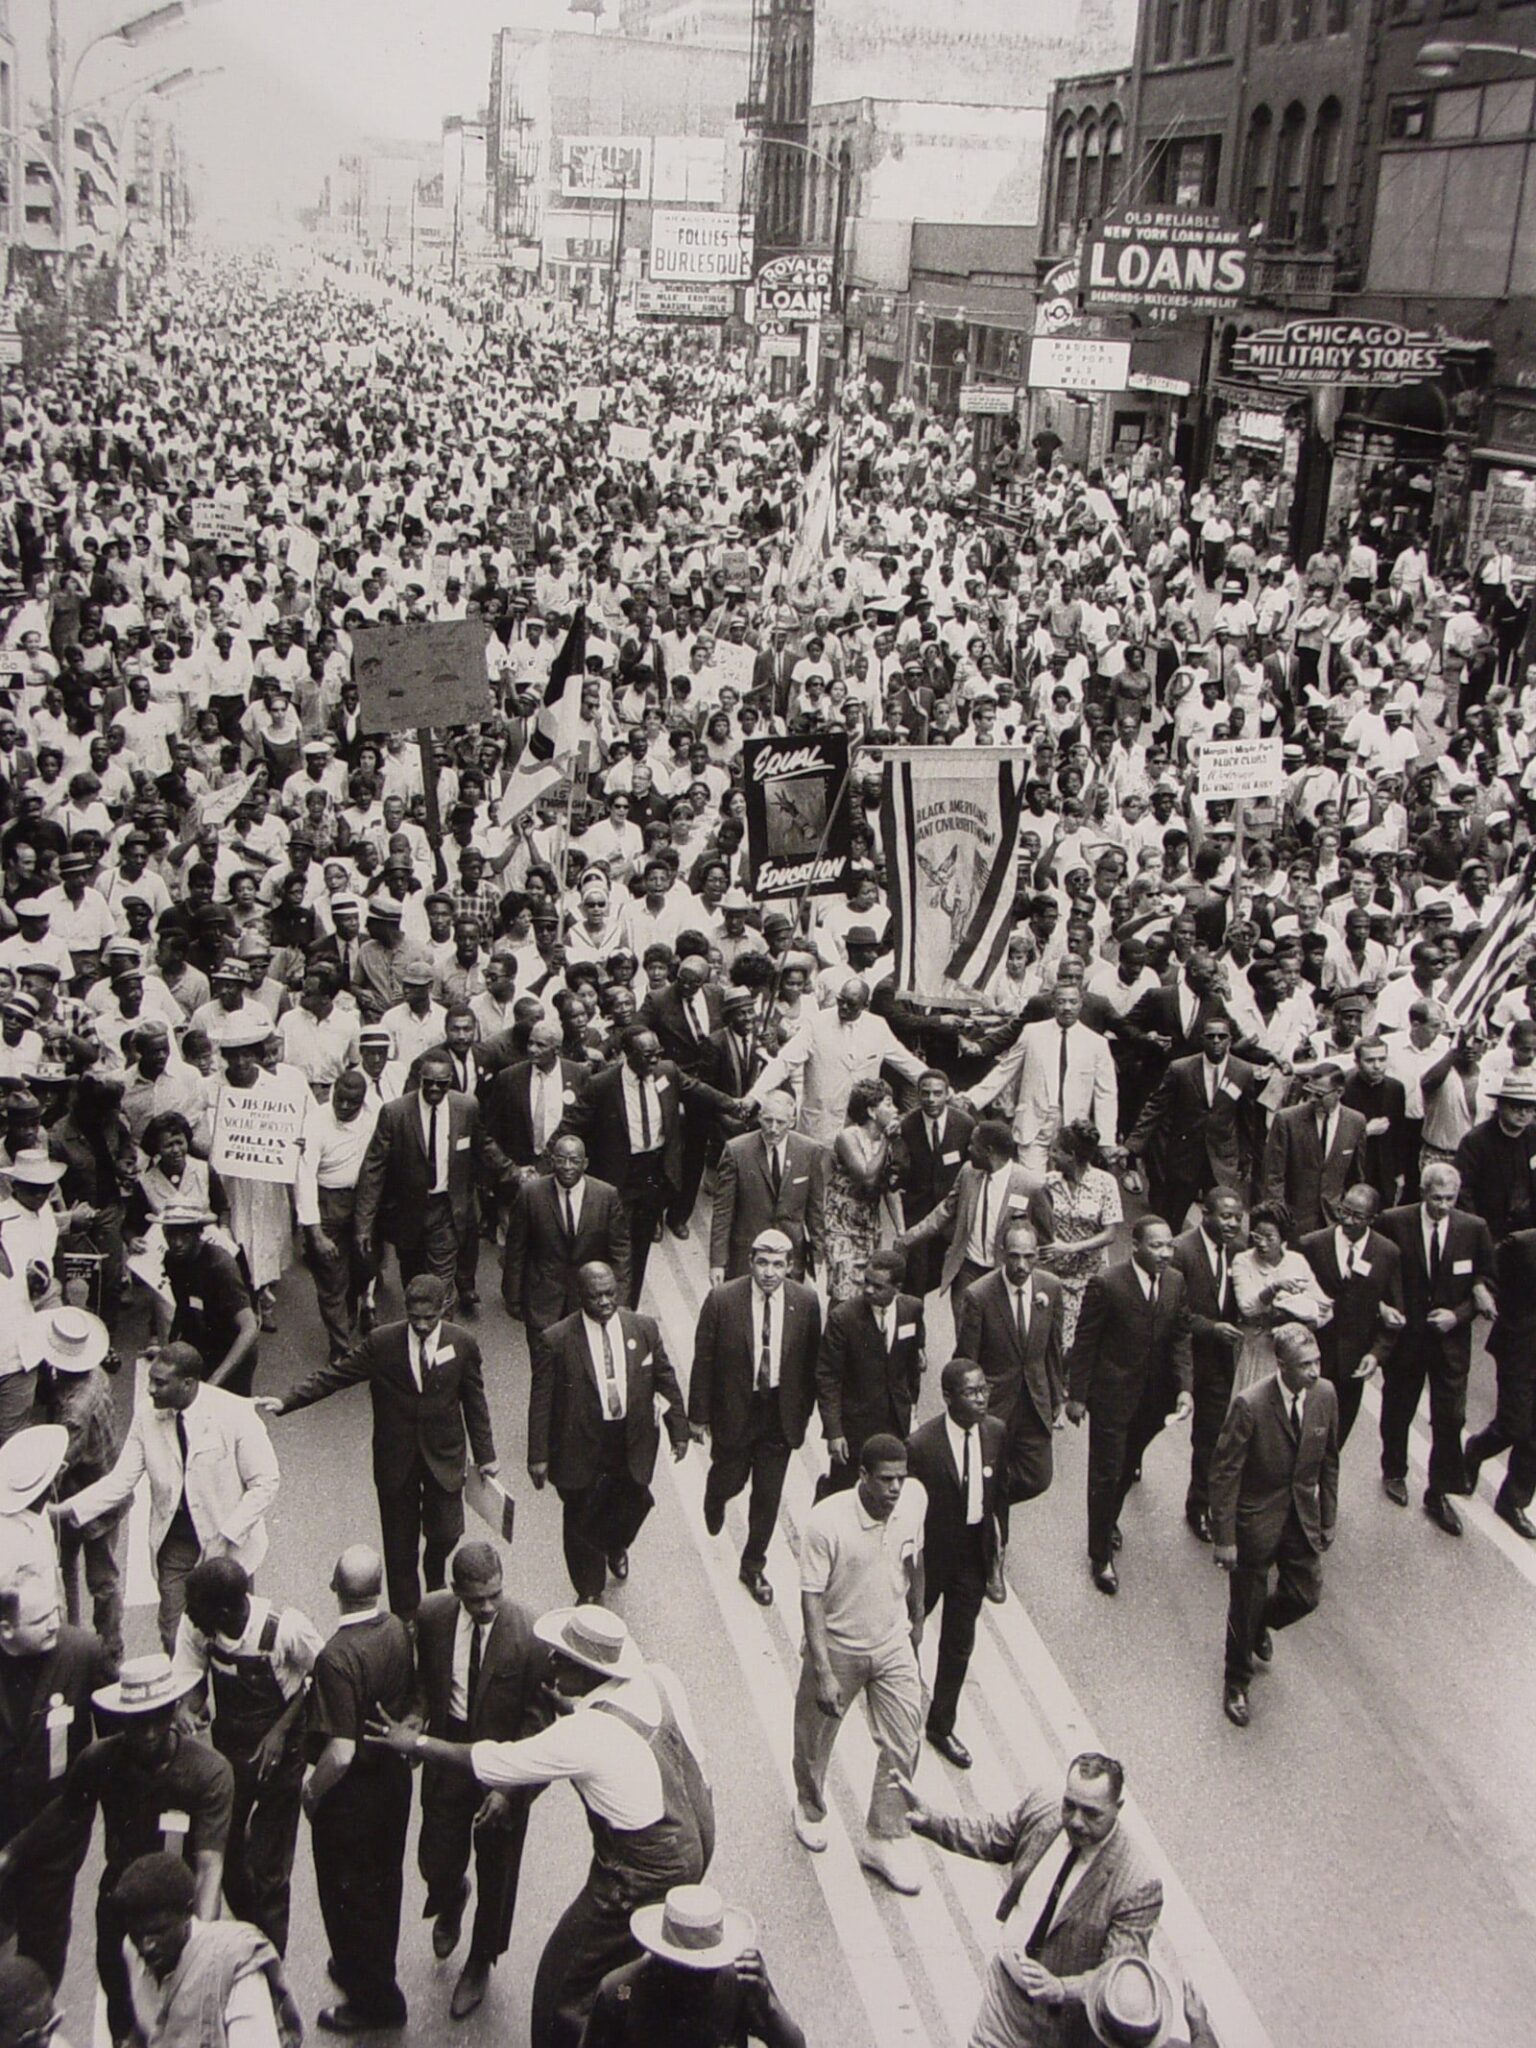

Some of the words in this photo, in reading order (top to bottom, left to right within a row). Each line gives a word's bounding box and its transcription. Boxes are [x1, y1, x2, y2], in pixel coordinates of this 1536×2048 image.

[1125, 211, 1152, 225] OLD
[1155, 213, 1220, 228] RELIABLE
[678, 228, 728, 248] FOLLIES
[1104, 225, 1133, 239] NEW
[1136, 228, 1170, 241] YORK
[1171, 229, 1204, 243] LOAN
[1205, 232, 1240, 245] BANK
[655, 247, 750, 277] BURLESQUE
[1090, 242, 1247, 293] LOANS
[1149, 307, 1178, 321] 416
[1291, 325, 1401, 345] CHICAGO
[1251, 345, 1356, 369] MILITARY
[1357, 348, 1438, 370] STORES
[753, 745, 825, 782] EQUAL
[916, 801, 945, 824] BLACK
[756, 856, 847, 893] EDUCATION
[229, 1133, 286, 1148] WILLIS
[225, 1150, 284, 1166] FRILLS
